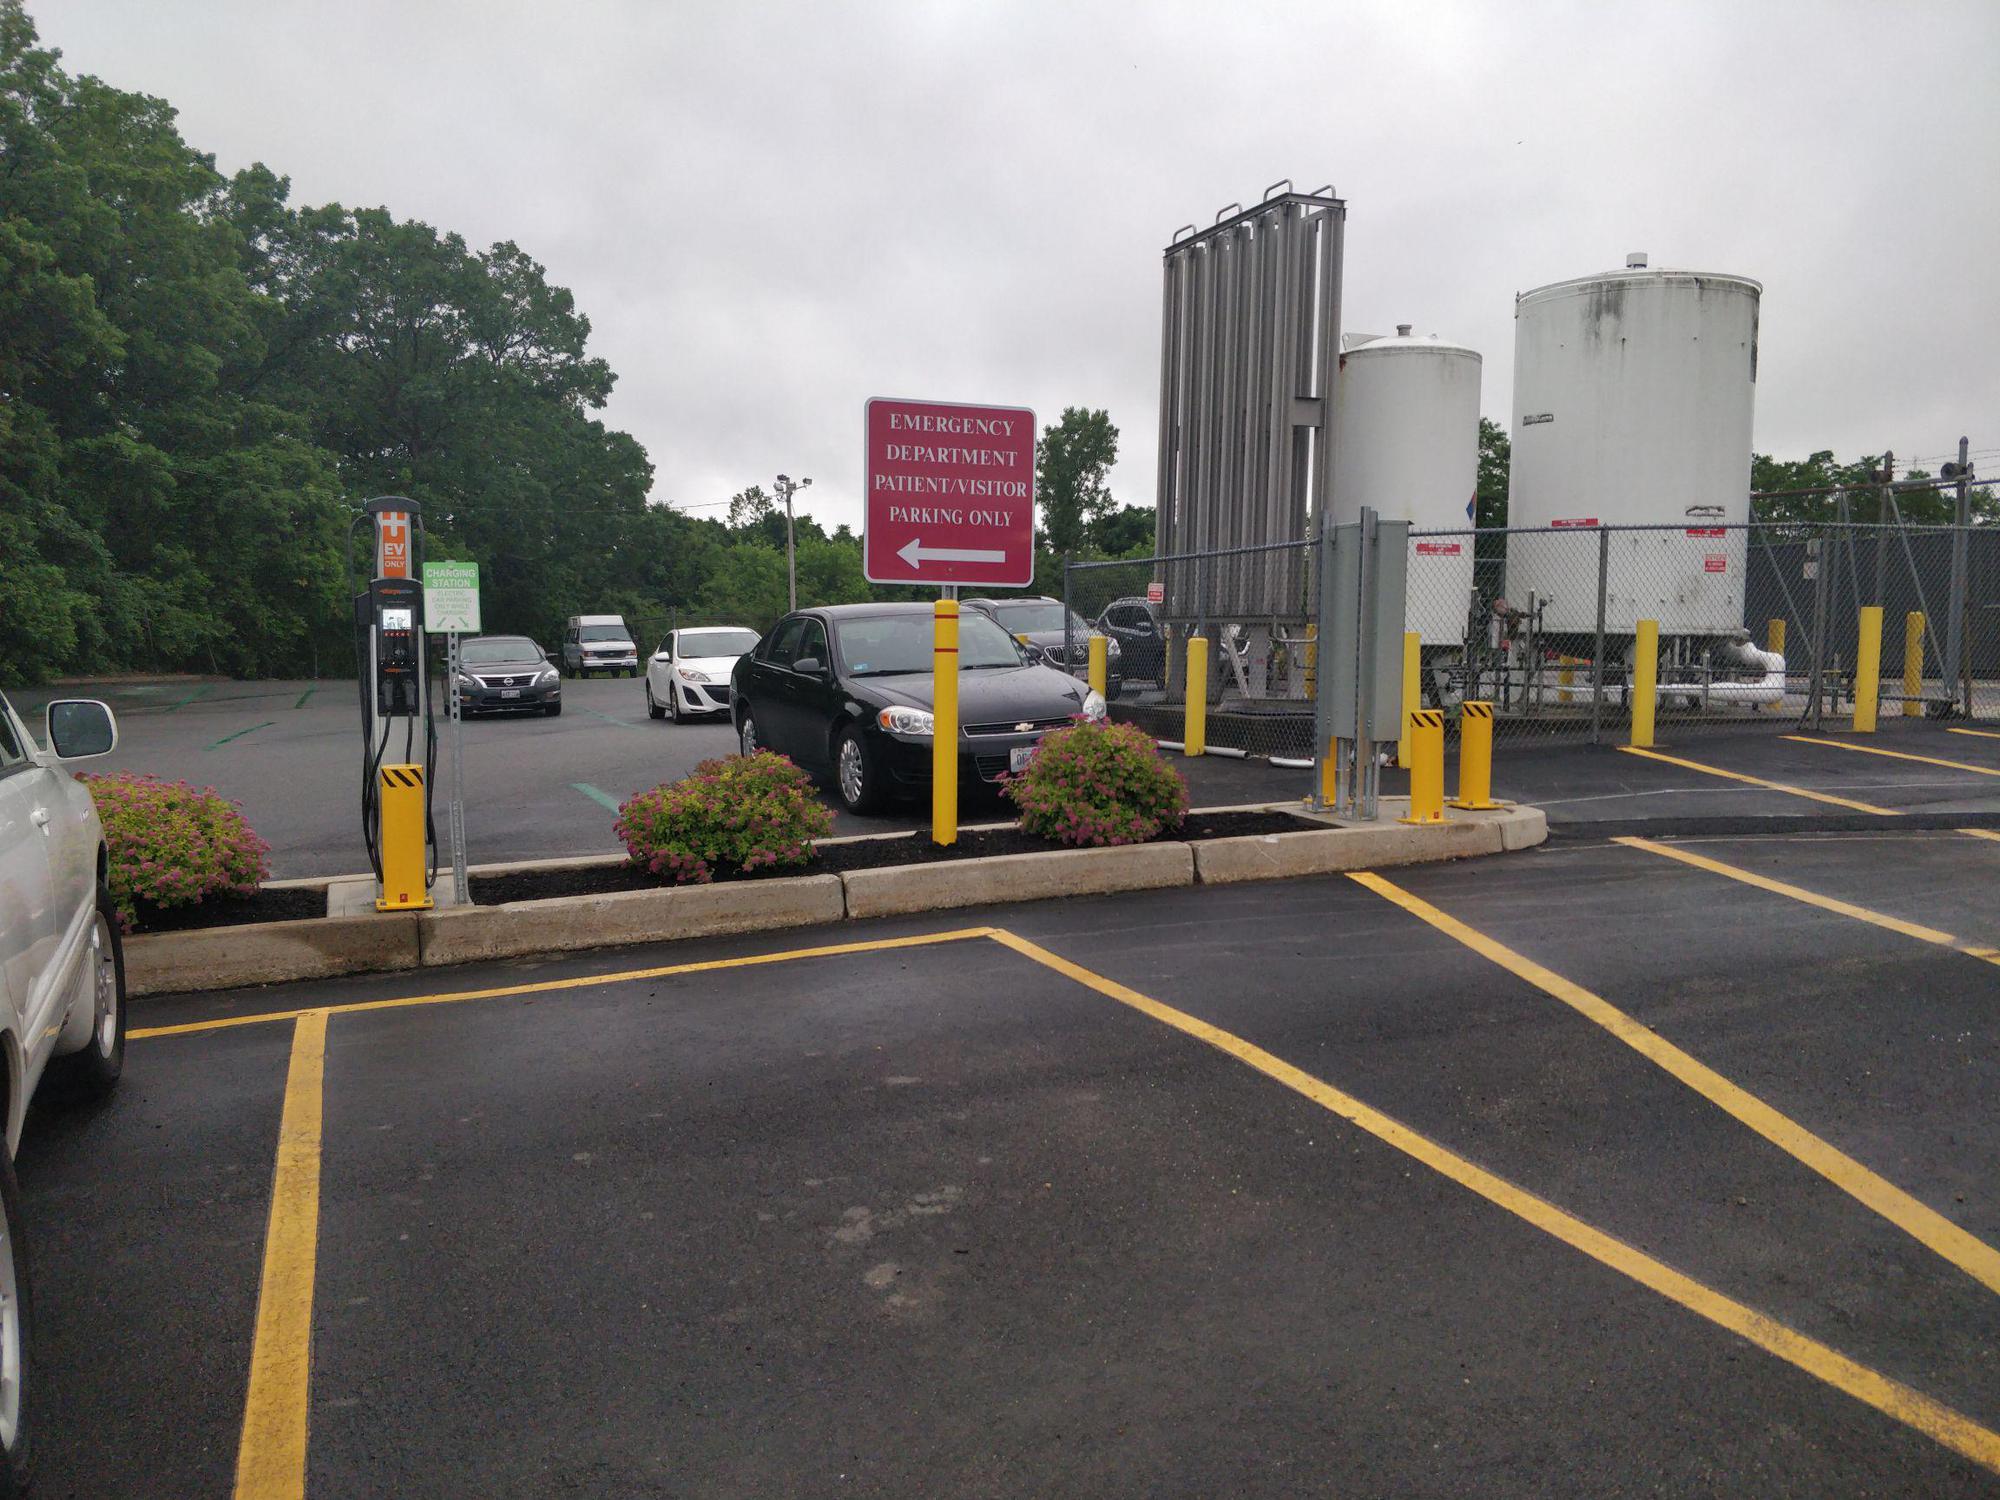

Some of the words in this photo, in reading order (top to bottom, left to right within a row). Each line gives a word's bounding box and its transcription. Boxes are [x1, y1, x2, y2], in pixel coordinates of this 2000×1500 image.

[889, 413, 1015, 437] EMERGENCY
[887, 444, 1018, 467] DEPARTMENT
[875, 474, 1027, 497] PATIENT/VISITOR
[889, 506, 963, 525] PARKING
[969, 511, 1014, 527] ONLY
[384, 543, 405, 556] EV
[426, 569, 476, 578] CHARGING
[432, 578, 471, 587] STATION
